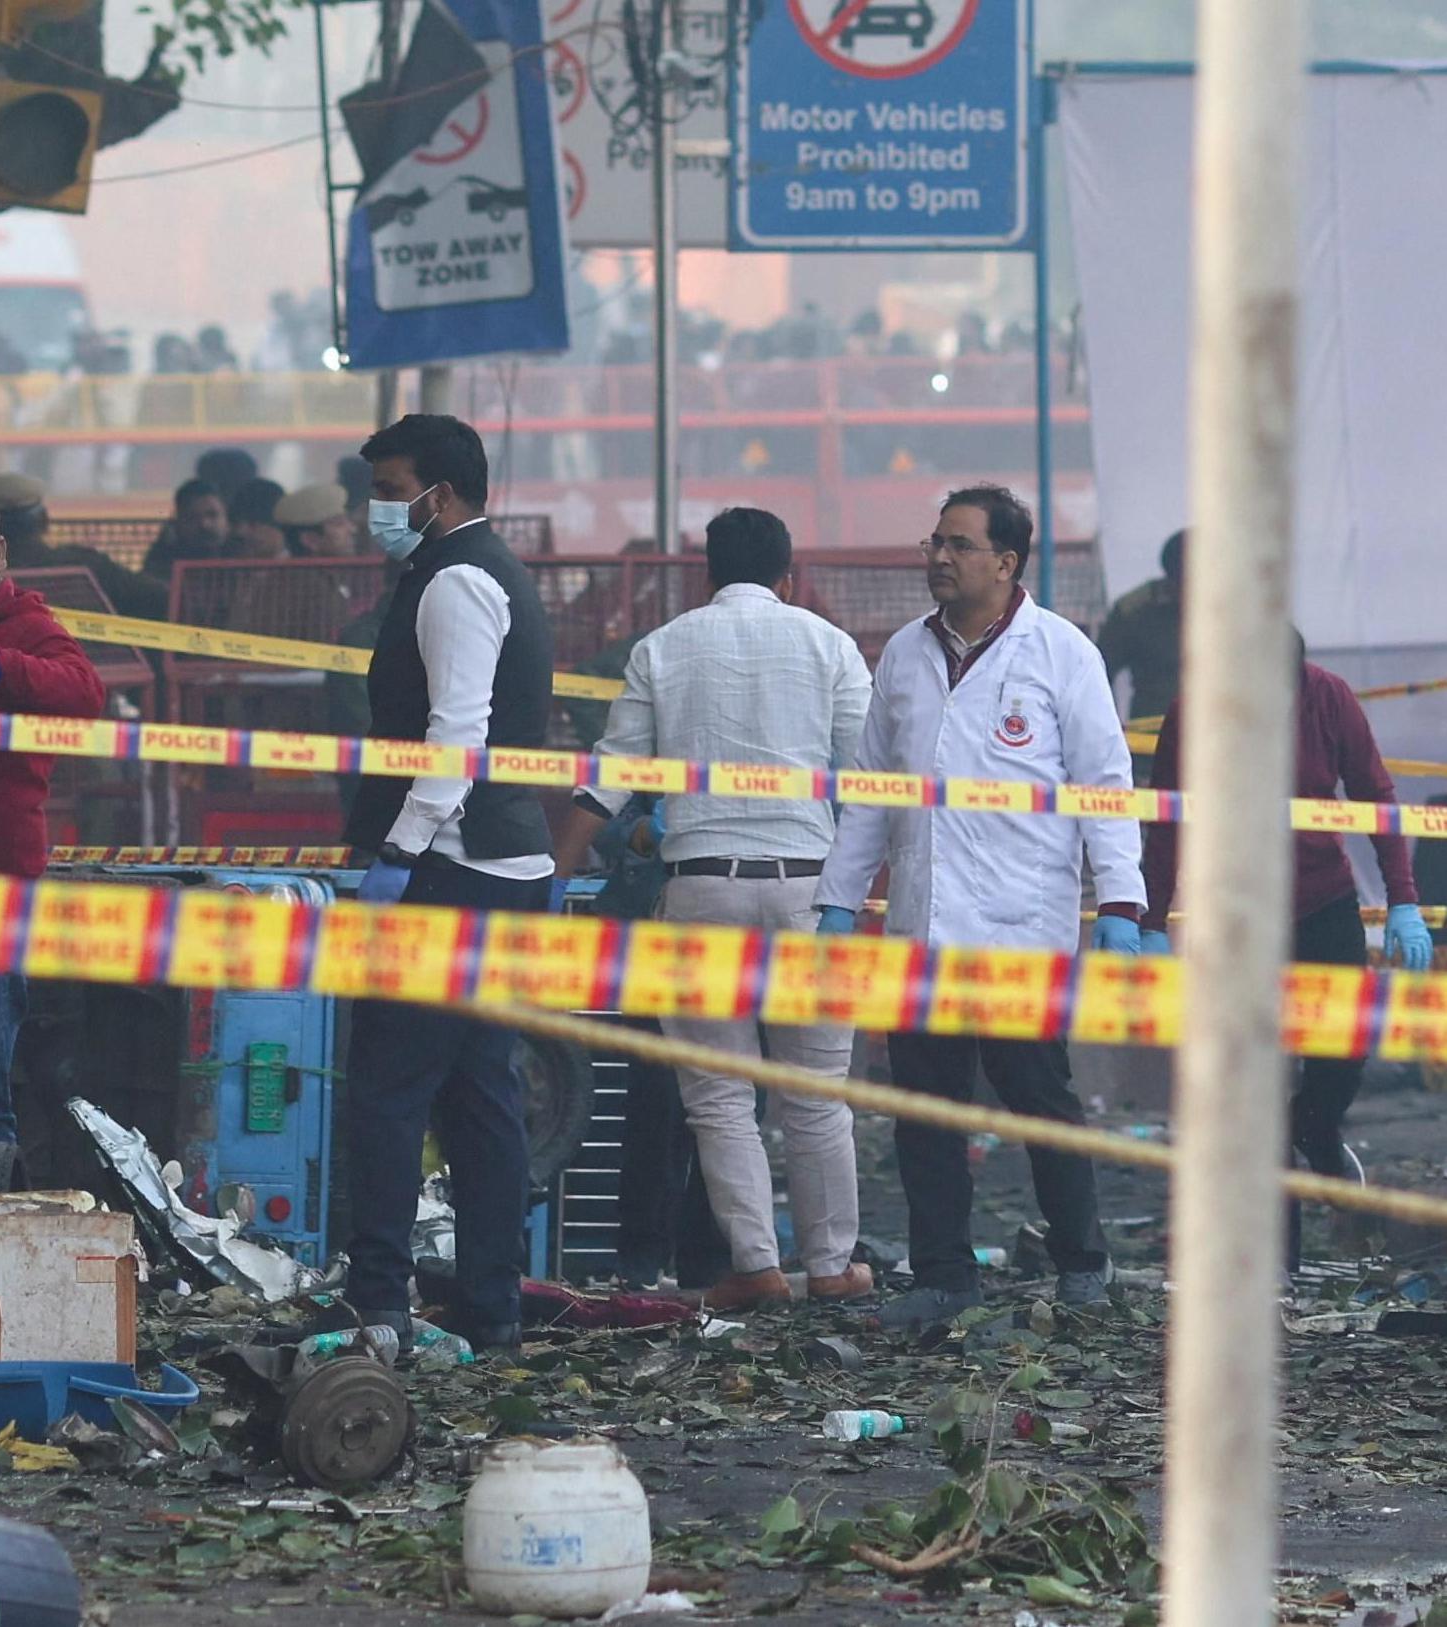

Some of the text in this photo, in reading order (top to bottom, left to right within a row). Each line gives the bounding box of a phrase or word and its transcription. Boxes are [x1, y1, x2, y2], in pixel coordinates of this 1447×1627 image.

[759, 102, 1006, 131] Motor Vehicles
[797, 142, 970, 171] Prohibited
[785, 181, 981, 217] 9am to 9pm
[380, 233, 522, 267] TOW AWAY
[415, 260, 490, 287] ZONE
[34, 730, 85, 749] LINE
[145, 731, 223, 753] POLICE
[384, 754, 433, 771] LINE
[495, 754, 573, 775] POLICE
[732, 776, 782, 794] LINE
[841, 777, 918, 797] POLICE
[1079, 798, 1127, 814] LINE
